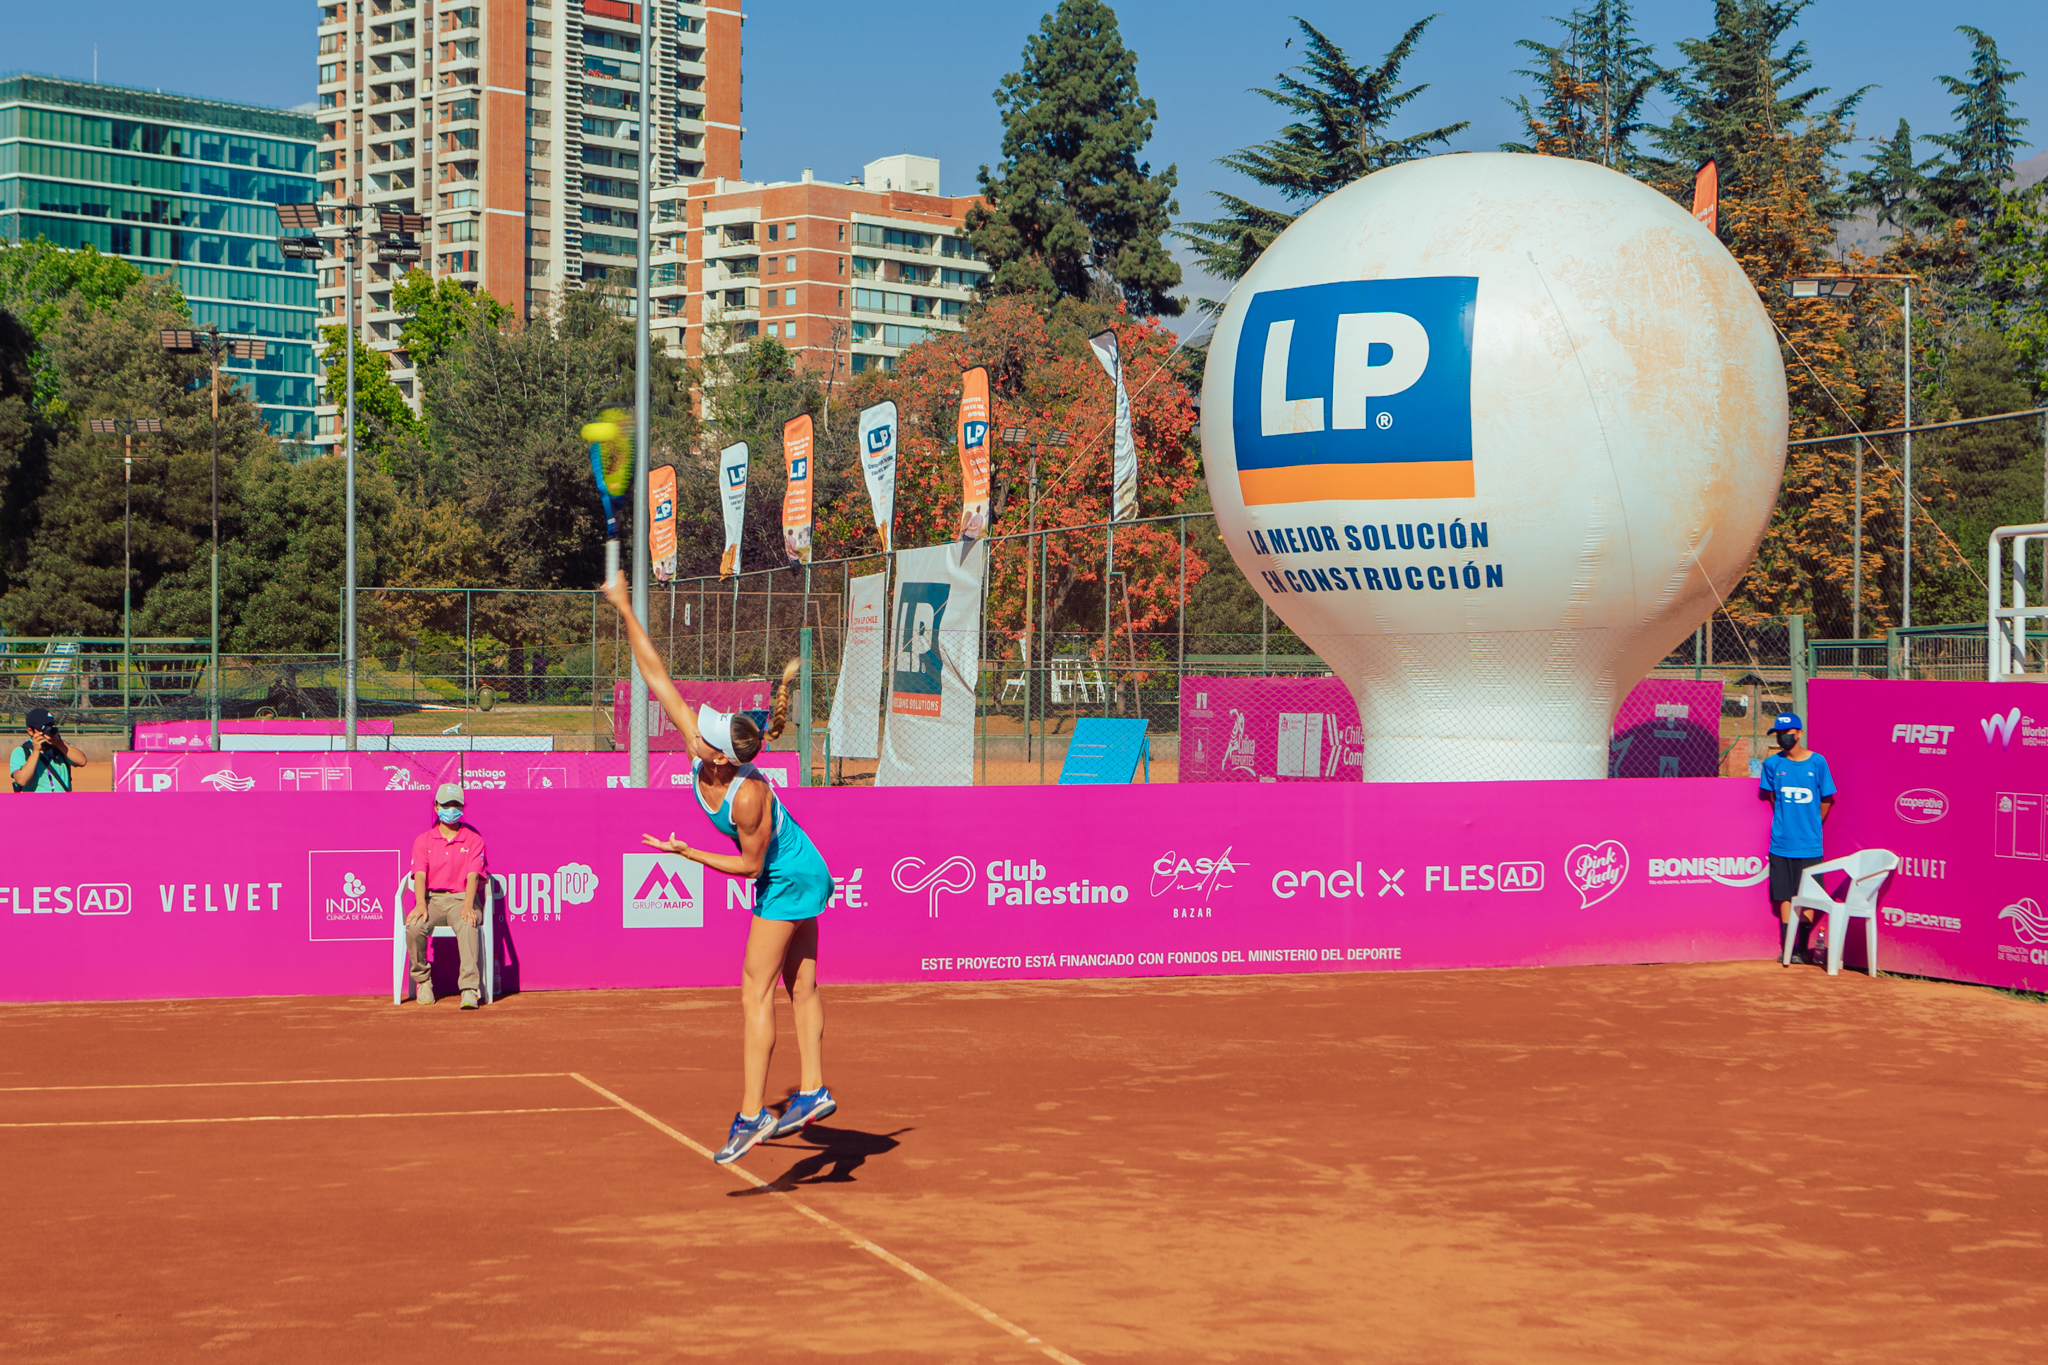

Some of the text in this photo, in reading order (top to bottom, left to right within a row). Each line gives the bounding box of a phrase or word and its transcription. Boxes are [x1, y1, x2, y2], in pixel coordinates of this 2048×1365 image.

[1261, 312, 1430, 437] LP
[870, 430, 889, 449] LP
[967, 424, 985, 445] LP
[790, 461, 806, 478] LP
[1247, 517, 1489, 555] LA MEJOR SOLUCIÓN
[1261, 561, 1504, 594] EN CONSTRUCCIÓN
[896, 602, 934, 673] LP
[910, 698, 939, 711] SOLUTIONS
[1891, 724, 1955, 745] FIRST
[1231, 755, 1255, 766] DEPORTES
[135, 774, 172, 792] LP
[458, 768, 506, 780] Santiago
[1780, 786, 1813, 804] TD
[1899, 797, 1944, 810] cooperativa
[986, 859, 1046, 881] Club
[1153, 857, 1236, 875] CASA
[1575, 846, 1618, 878] Pink
[1897, 856, 1946, 879] VELVET
[1271, 861, 1364, 898] enel
[1581, 865, 1620, 890] Lady
[159, 883, 282, 912] VELVET
[987, 879, 1129, 906] Palestino
[326, 898, 383, 913] INDISA
[632, 901, 694, 909] GRUPO MAIPO
[1173, 908, 1212, 918] BAZAR
[498, 914, 561, 922] OPCORN
[921, 947, 1402, 971] ESTE PROYECTO ESTÁ FINANCIADO CON FONDOS DEL MINISTERIO DEL DEPORTE
